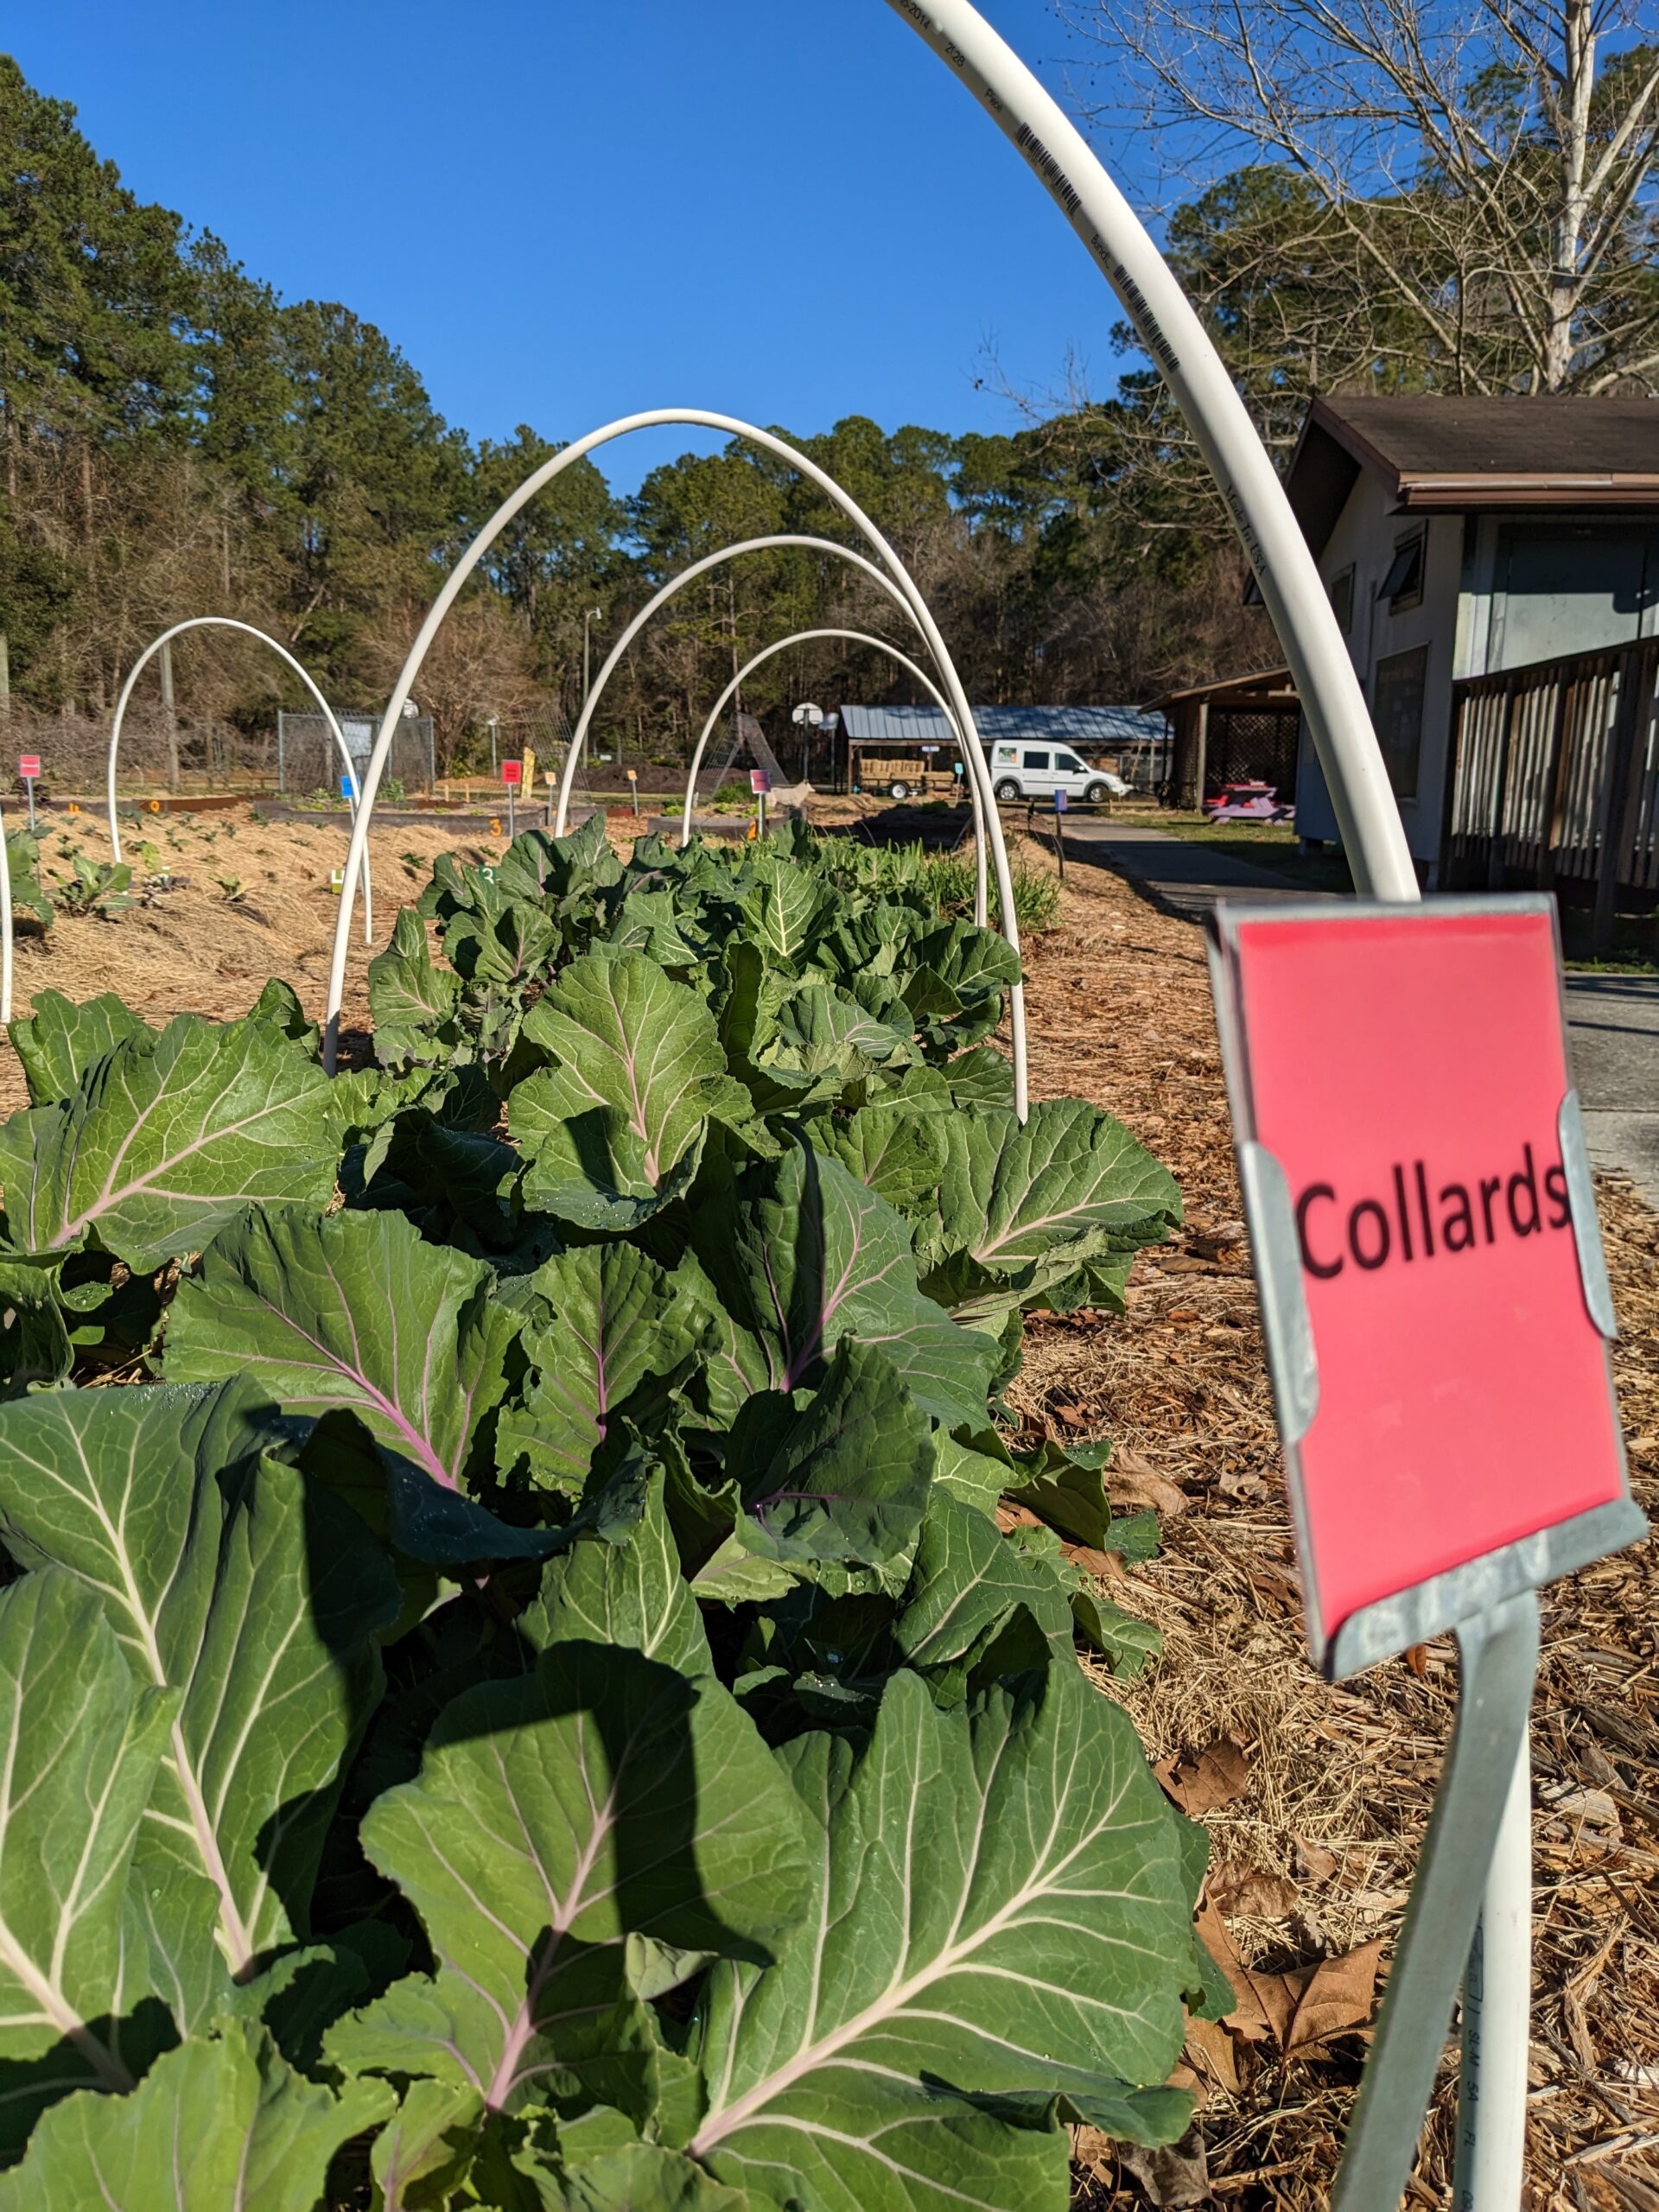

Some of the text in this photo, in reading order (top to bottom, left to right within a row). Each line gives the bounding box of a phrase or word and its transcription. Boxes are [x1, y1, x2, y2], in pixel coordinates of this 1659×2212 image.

[1225, 485, 1266, 576] Made In USA
[1295, 1142, 1573, 1280] Collards
